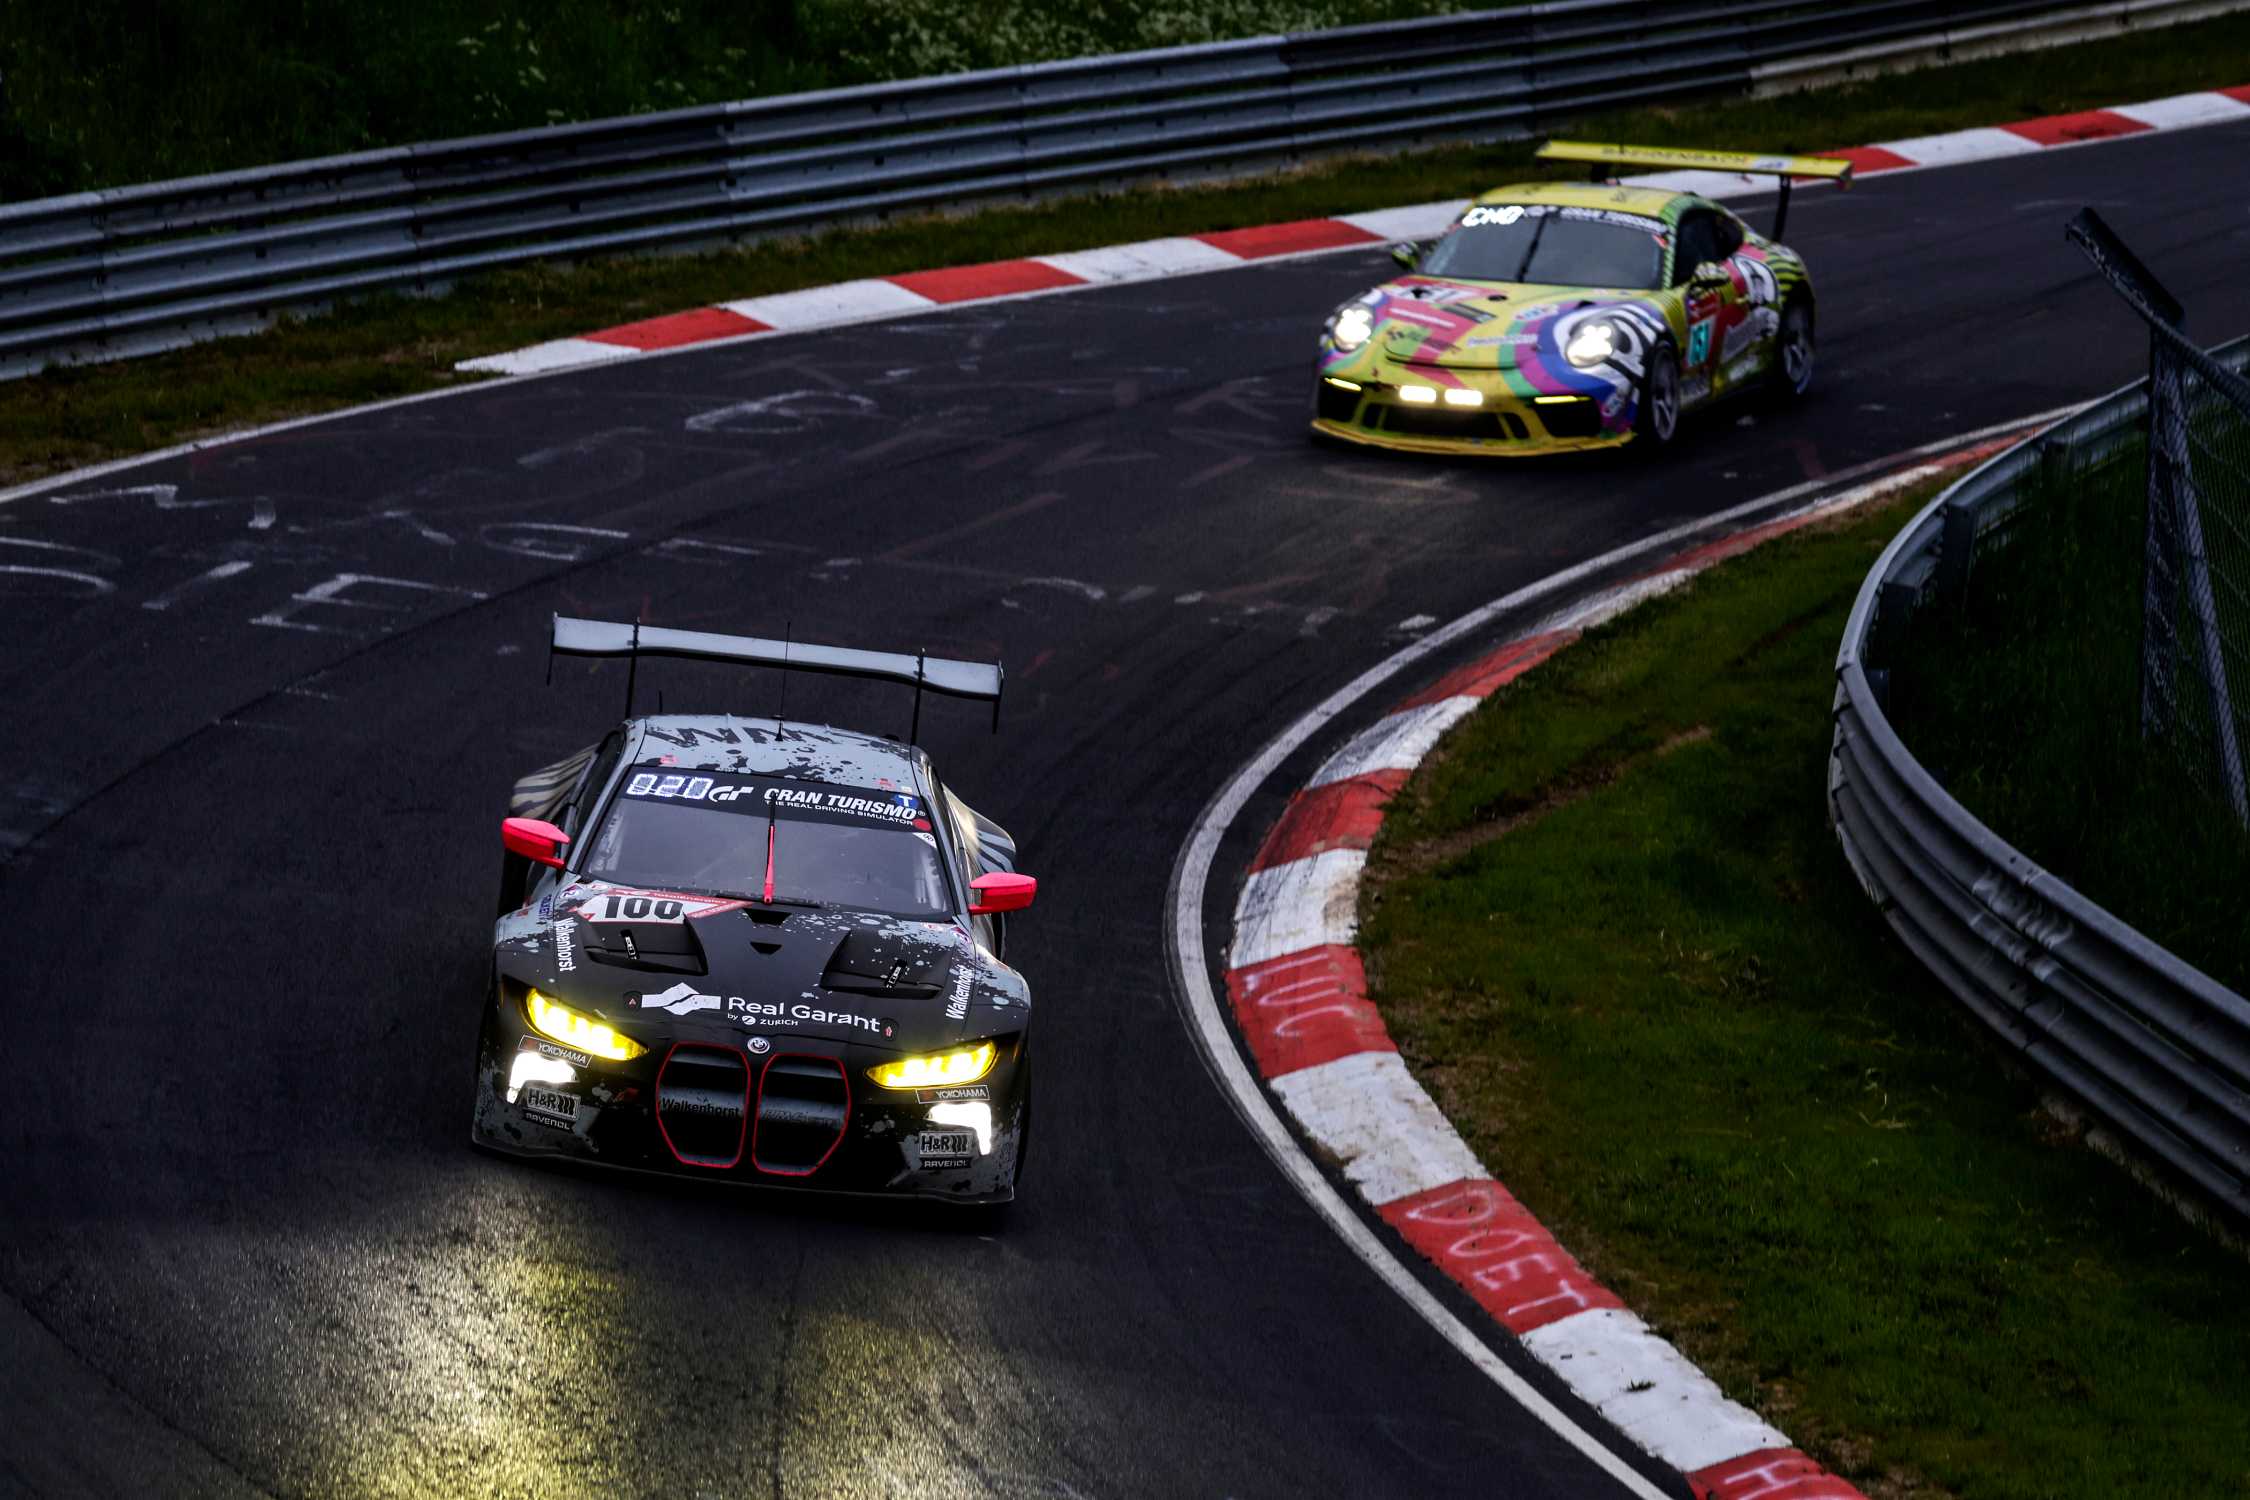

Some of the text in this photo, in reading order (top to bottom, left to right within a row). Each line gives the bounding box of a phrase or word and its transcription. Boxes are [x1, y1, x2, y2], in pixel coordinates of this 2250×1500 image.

[764, 788, 823, 805] GRAN
[788, 801, 812, 809] REAL
[815, 805, 855, 815] DRIVING
[858, 812, 914, 826] SIMULATOR
[605, 896, 684, 920] 100
[555, 917, 579, 972] Walkenhorst
[727, 1012, 738, 1021] by
[759, 1018, 799, 1026] ZURICH
[728, 996, 881, 1033] Real Garant
[539, 1043, 587, 1064] YOKOHAMA
[936, 1088, 987, 1099] YOKOHAMA
[662, 1097, 741, 1118] Walkenhorst
[920, 1134, 950, 1153] H&R
